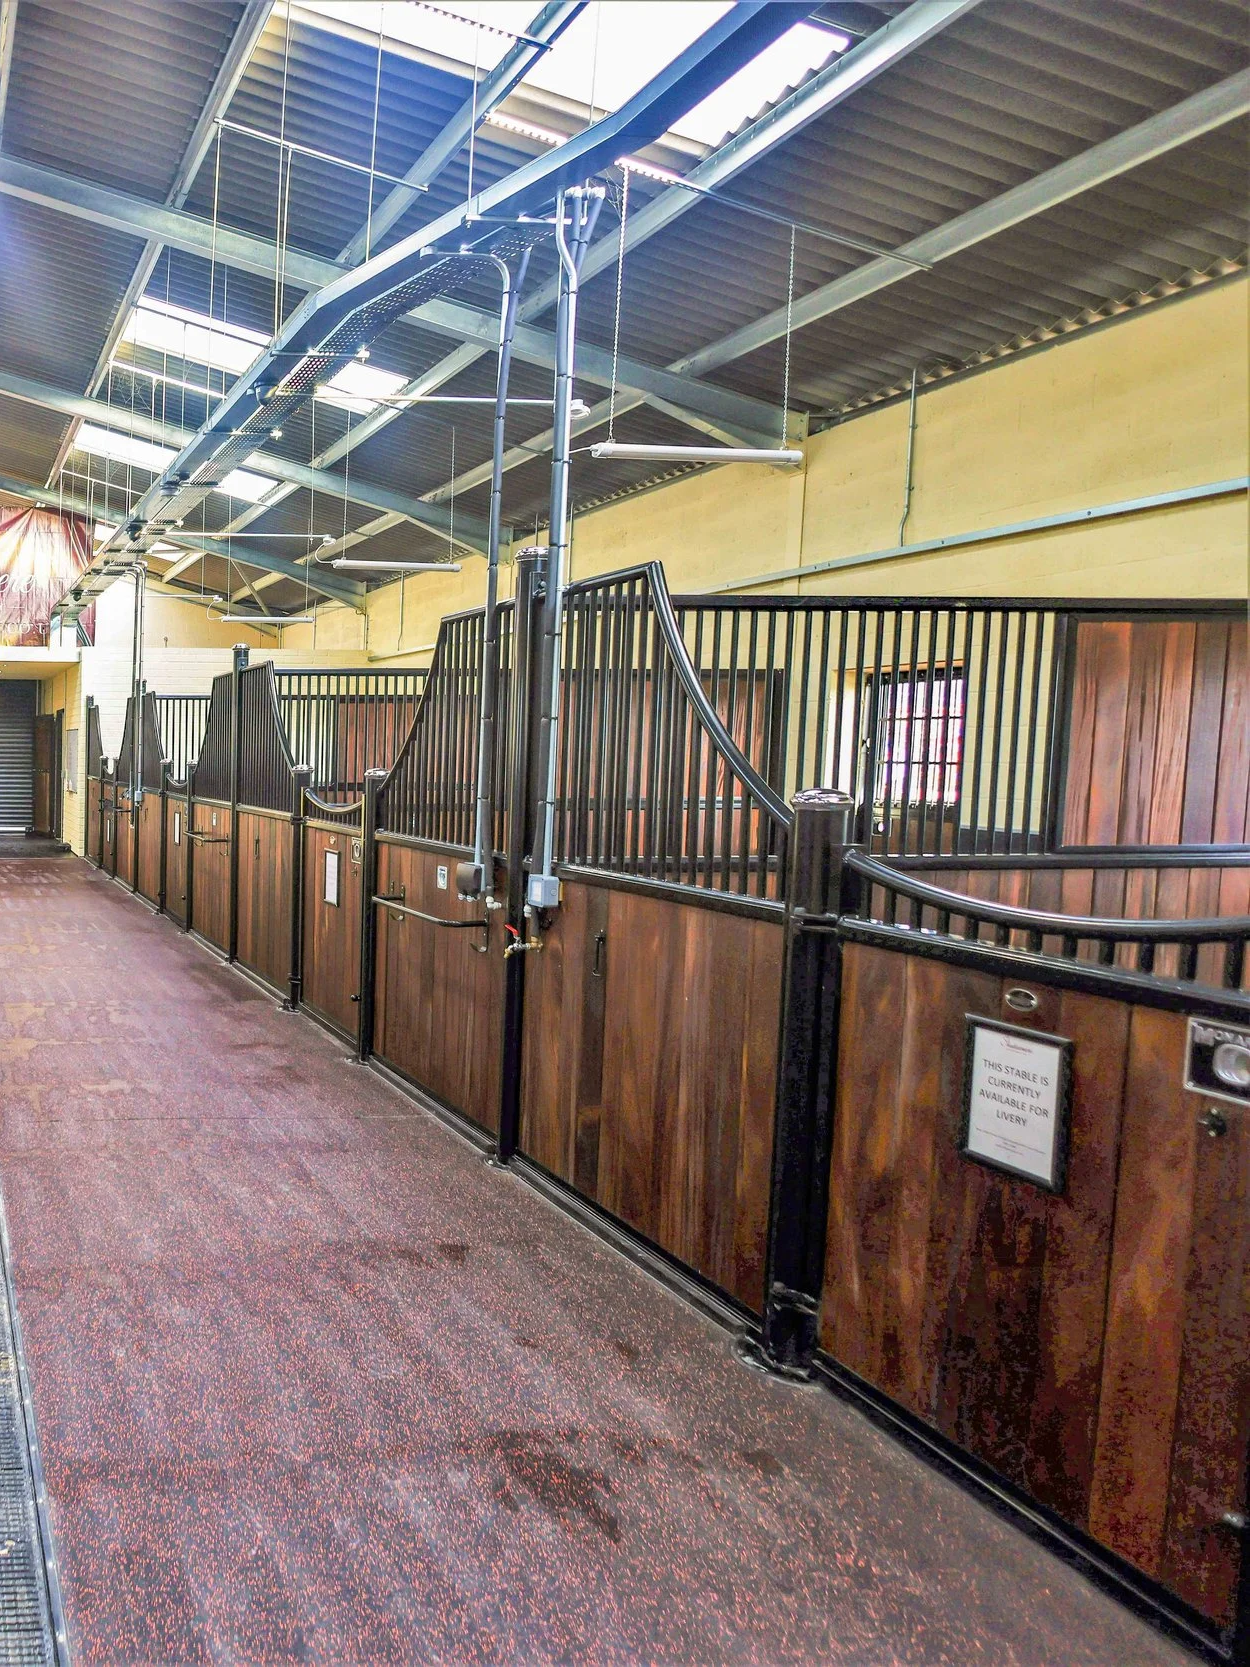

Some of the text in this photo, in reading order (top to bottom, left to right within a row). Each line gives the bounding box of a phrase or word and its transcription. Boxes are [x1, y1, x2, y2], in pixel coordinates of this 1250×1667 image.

[982, 1058, 1050, 1087] THIS STABLE IS
[987, 1075, 1041, 1099] CURRENTLY
[979, 1088, 1049, 1118] AVAILABLE FOR
[996, 1109, 1027, 1126] LIVERY
